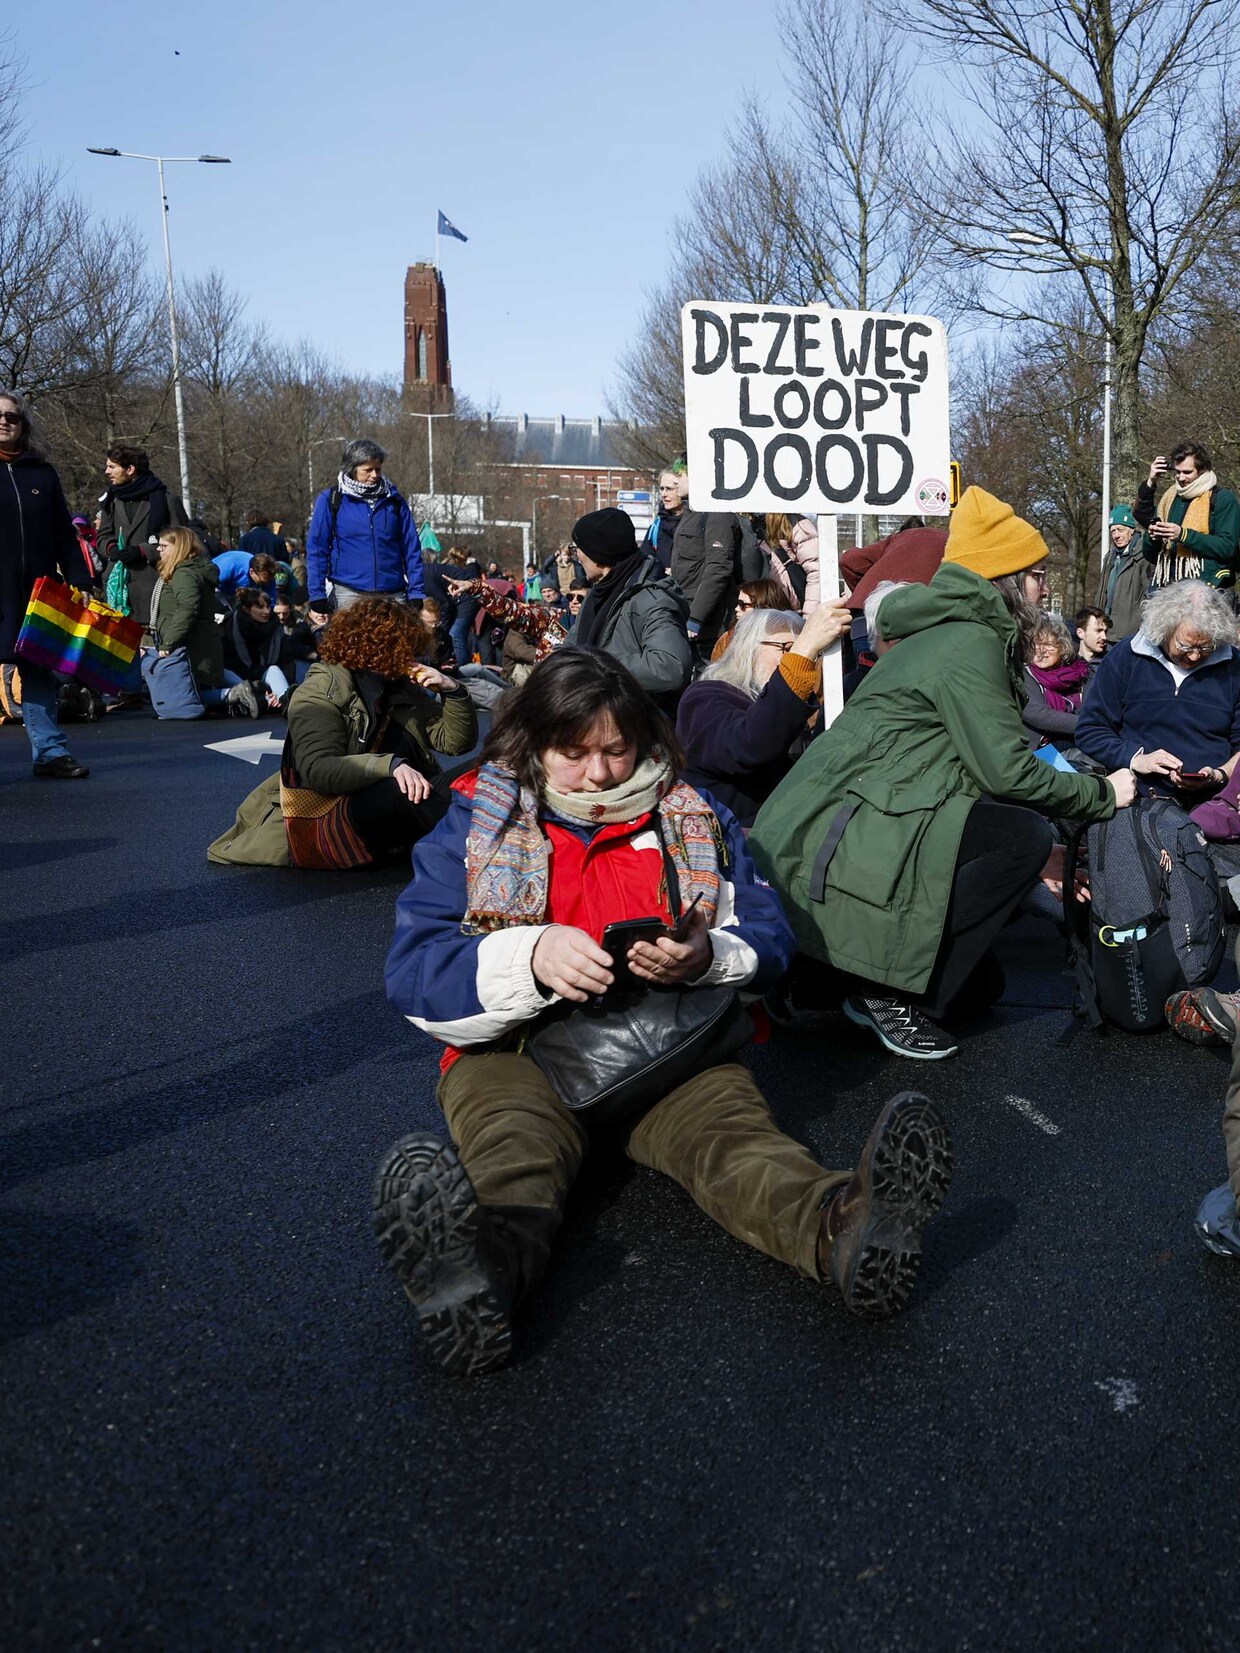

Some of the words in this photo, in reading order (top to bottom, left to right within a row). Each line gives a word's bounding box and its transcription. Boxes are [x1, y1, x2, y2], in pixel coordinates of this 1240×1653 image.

[690, 309, 825, 377] DEZE
[831, 317, 932, 383] WEG
[739, 376, 921, 437] LOOPT
[708, 428, 914, 506] DOOD
